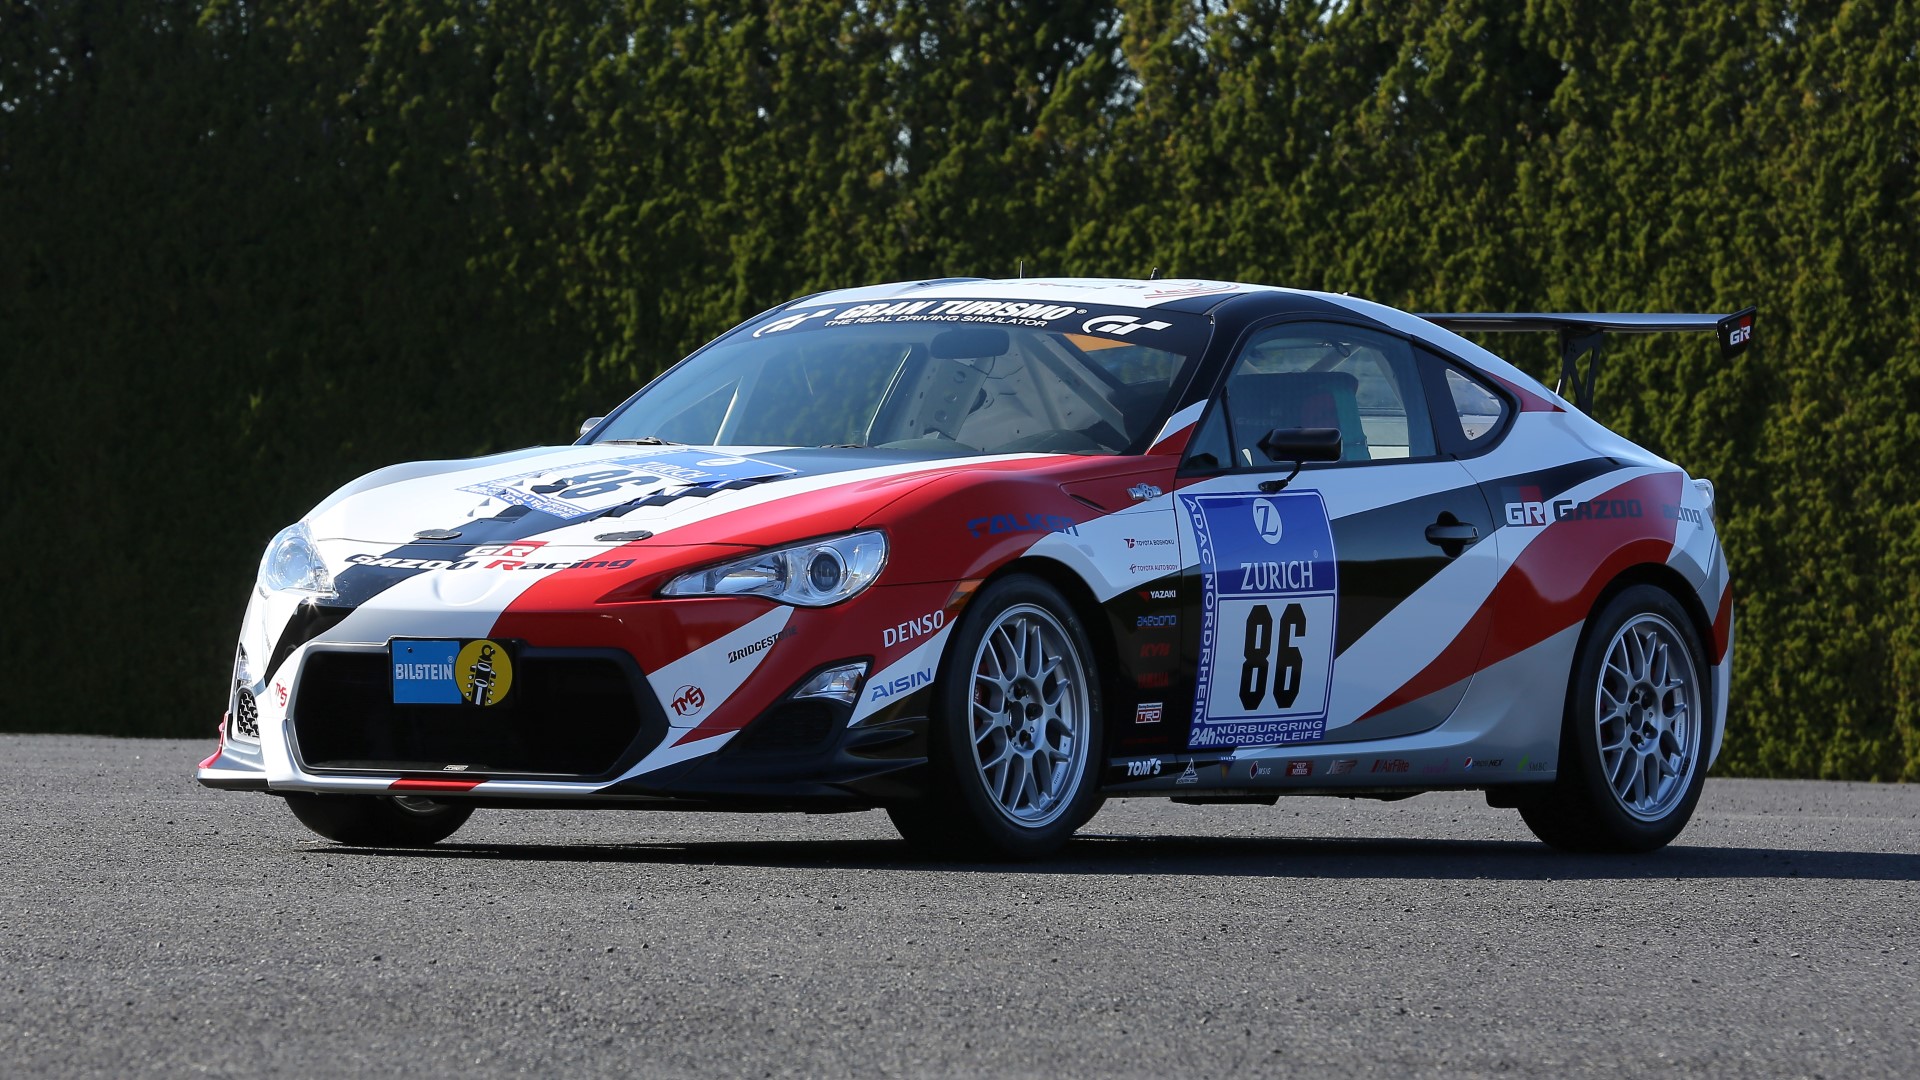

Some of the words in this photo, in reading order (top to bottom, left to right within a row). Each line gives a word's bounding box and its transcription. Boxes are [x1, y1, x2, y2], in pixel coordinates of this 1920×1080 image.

[824, 318, 854, 327] THE
[854, 316, 892, 325] REAL
[960, 315, 1049, 328] SIMULATOR
[835, 301, 937, 319] GRAN
[928, 301, 1077, 321] TURISMO
[1730, 325, 1751, 346] GR
[629, 461, 713, 480] ZURICH
[1505, 501, 1546, 525] GR
[966, 513, 1079, 538] FALKEN
[1183, 497, 1212, 565] ADAC
[464, 545, 536, 558] GR
[484, 558, 637, 570] Racing
[1240, 560, 1314, 591] ZURICH
[1150, 590, 1176, 599] YAZAKI
[883, 610, 945, 648] DENSO
[727, 625, 798, 664] BRIDGESTONE
[1193, 573, 1214, 724] NORDRHEIN
[1239, 603, 1306, 711] 86
[395, 663, 453, 680] BILSTEIN
[871, 667, 932, 702] AISIN
[1139, 710, 1160, 722] TRD
[1189, 727, 1216, 746] 24h
[1217, 721, 1323, 735] NÜRBURGRING
[1214, 730, 1322, 744] NORDSCHLEIFE
[1127, 758, 1162, 776] TOM'S
